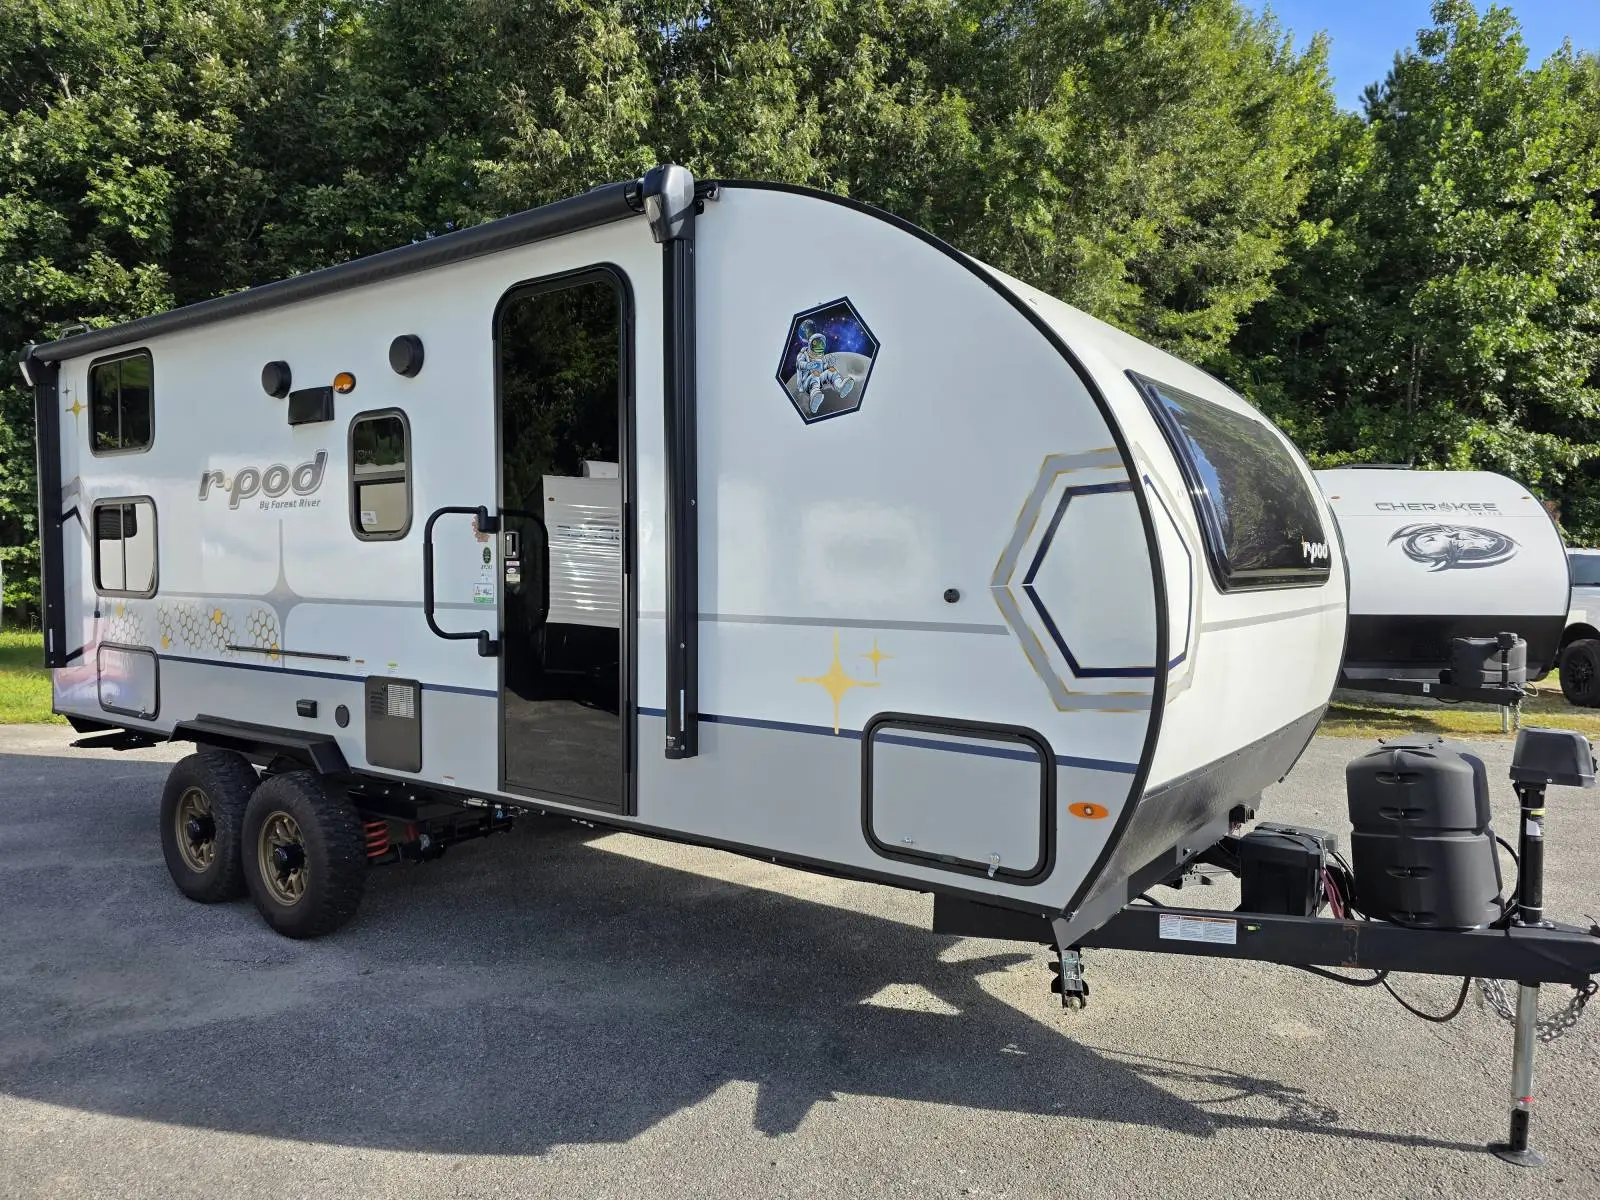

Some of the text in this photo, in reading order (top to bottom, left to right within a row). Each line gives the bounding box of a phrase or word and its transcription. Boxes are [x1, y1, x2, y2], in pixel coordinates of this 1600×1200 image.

[259, 498, 321, 511] By Forest River
[1374, 502, 1499, 512] CHEROKEE
